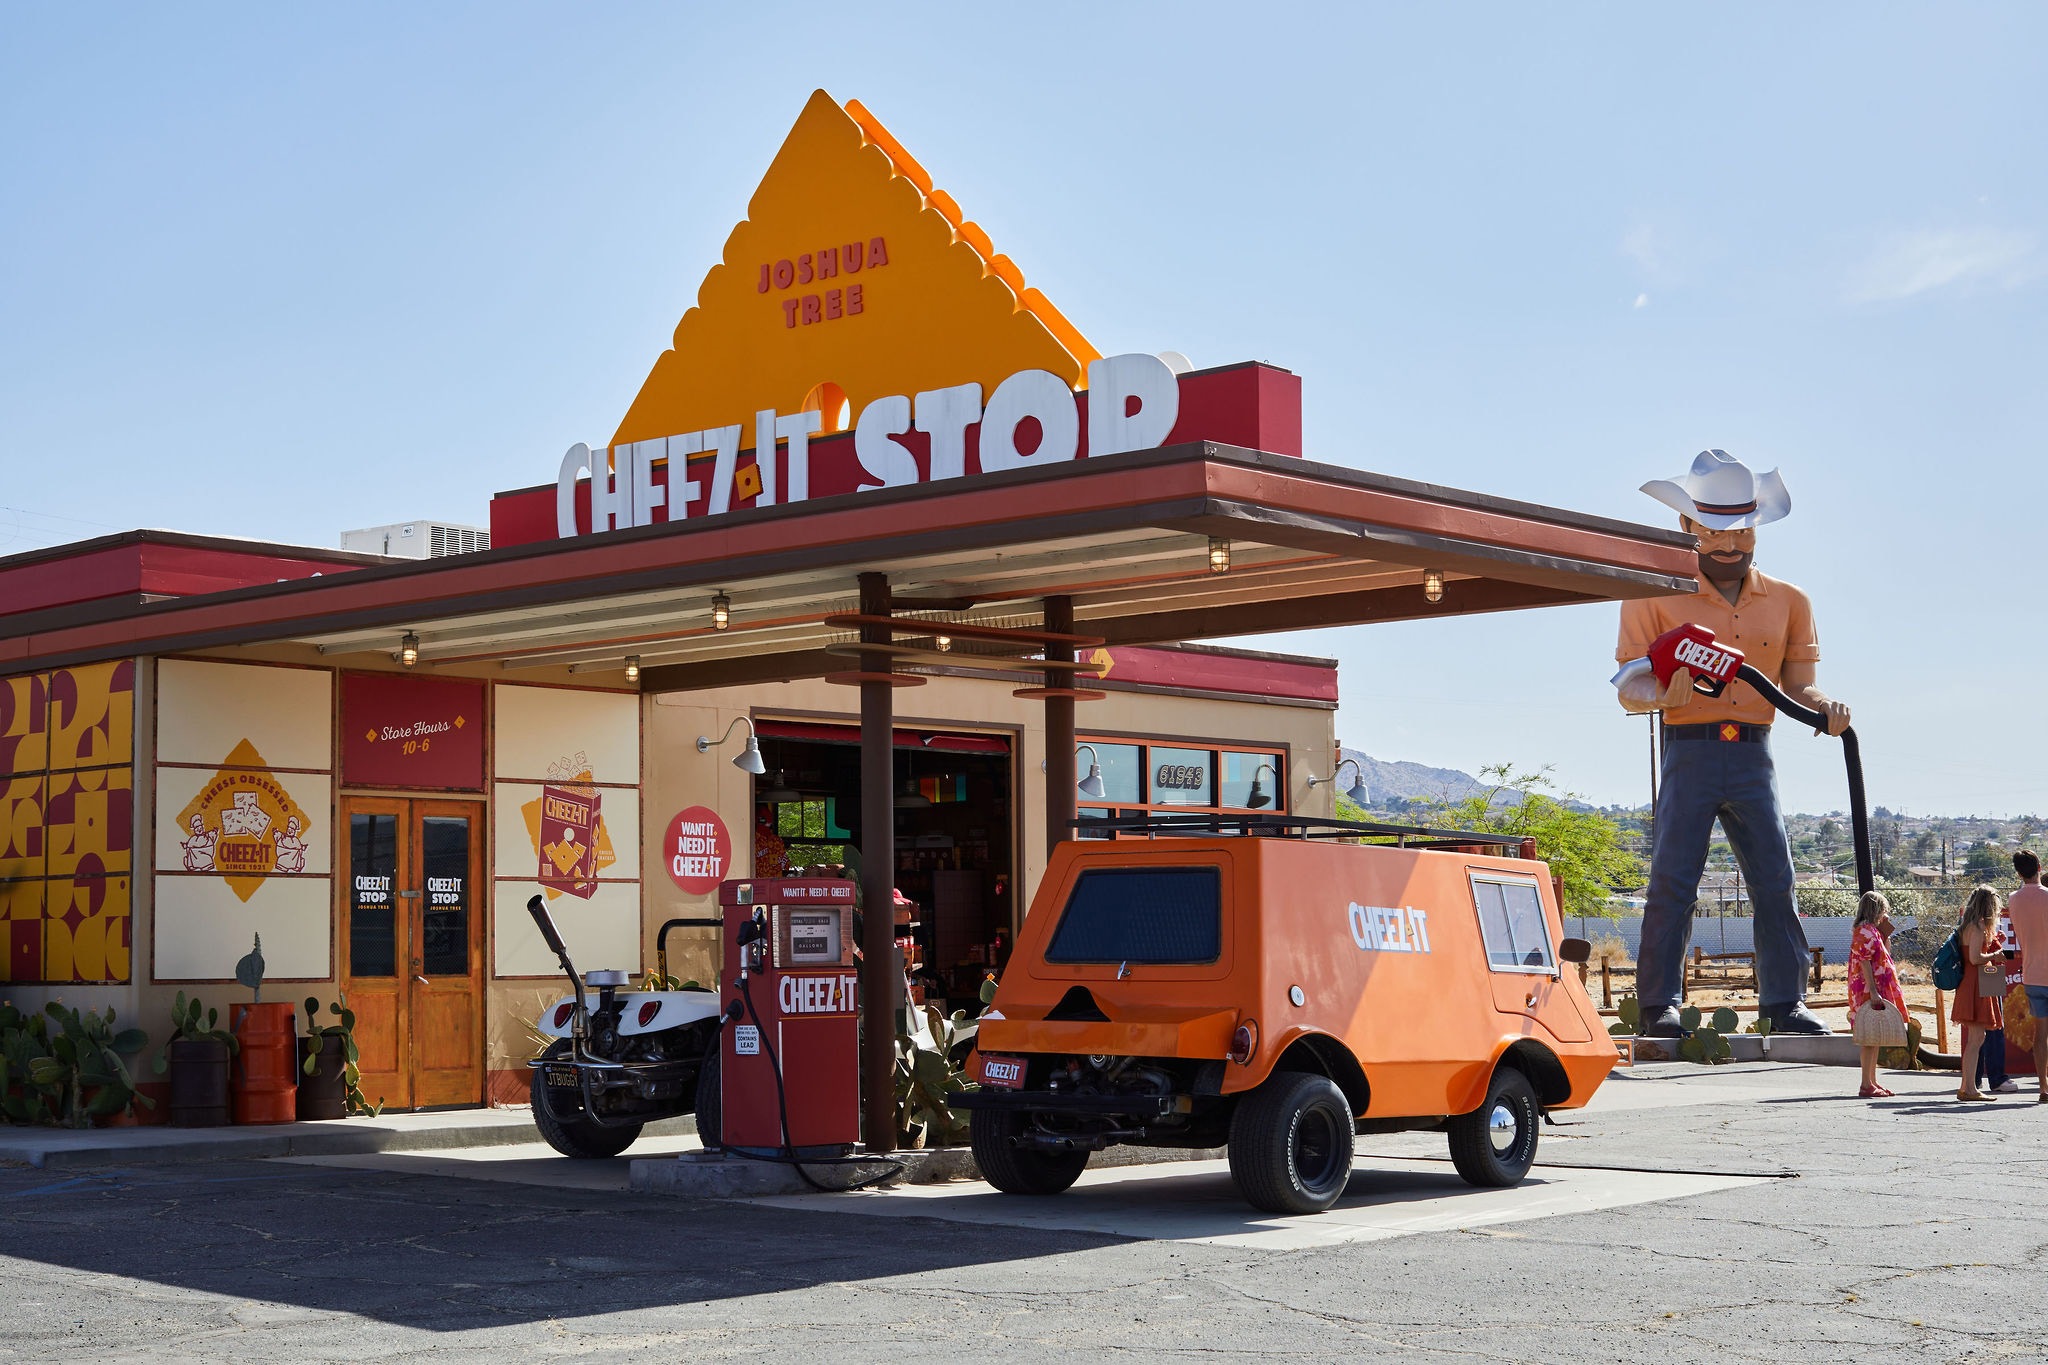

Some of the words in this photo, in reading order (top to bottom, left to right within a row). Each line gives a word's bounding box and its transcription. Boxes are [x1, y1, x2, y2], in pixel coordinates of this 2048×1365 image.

[757, 236, 889, 294] JOSHUA
[781, 283, 864, 329] TREE
[855, 353, 1180, 493] STOP
[1674, 637, 1736, 677] CHEEZ-IT
[380, 726, 412, 741] Store
[413, 721, 452, 736] Hours
[402, 738, 431, 756] 10-6
[1157, 765, 1204, 789] 61943
[200, 776, 237, 810] CHEESE
[239, 774, 289, 813] OBSESSED
[681, 821, 706, 836] WANT
[220, 841, 272, 864] CHEEZ-IT
[678, 836, 706, 855] NEED
[225, 863, 247, 871] SINCE
[673, 854, 722, 878] CHEEZ-IT
[355, 875, 391, 891] CHEEZ-IT
[427, 877, 462, 892] CHEEZ-IT
[782, 887, 800, 897] WANT
[809, 887, 823, 897] NEED
[359, 892, 388, 903] STOP
[431, 893, 460, 904] STOP
[1348, 901, 1431, 954] CHEEZ-IT
[779, 975, 857, 1014] CHEEZ-IT
[547, 1072, 579, 1088] JTBUGGY
